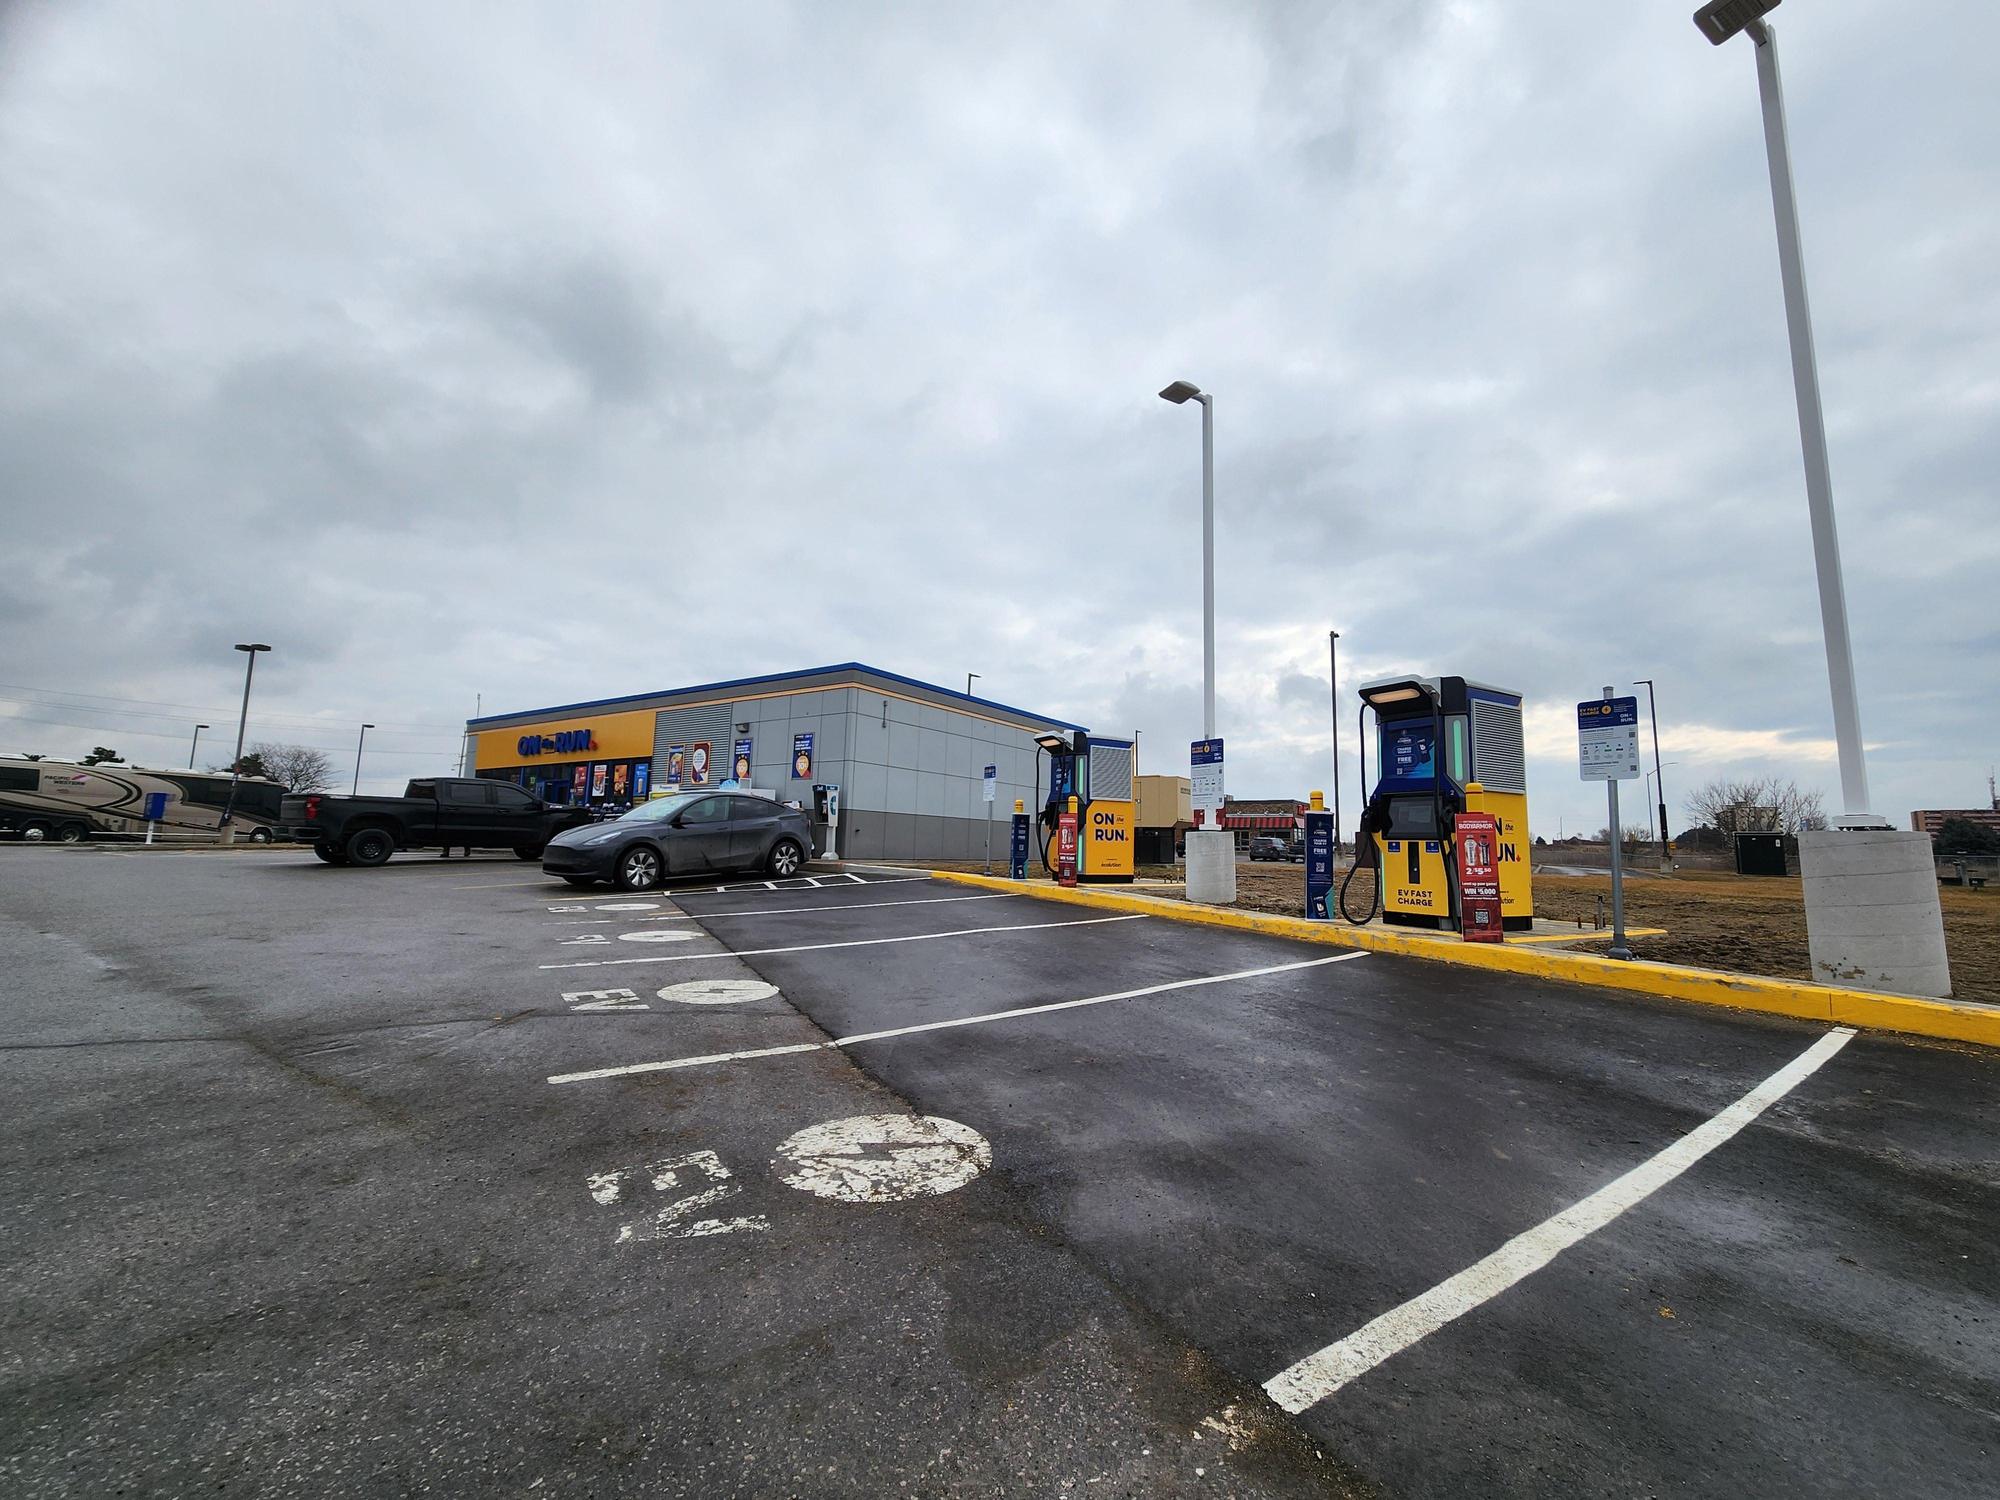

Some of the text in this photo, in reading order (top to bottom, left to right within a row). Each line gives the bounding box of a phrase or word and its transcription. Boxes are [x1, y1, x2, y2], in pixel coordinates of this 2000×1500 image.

[518, 735, 541, 756] ON
[555, 729, 591, 753] RUN
[1094, 813, 1114, 825] ON
[1096, 829, 1124, 841] RUN
[1411, 890, 1432, 898] FAST
[1398, 898, 1432, 906] CHARGE
[561, 988, 650, 1011] EV
